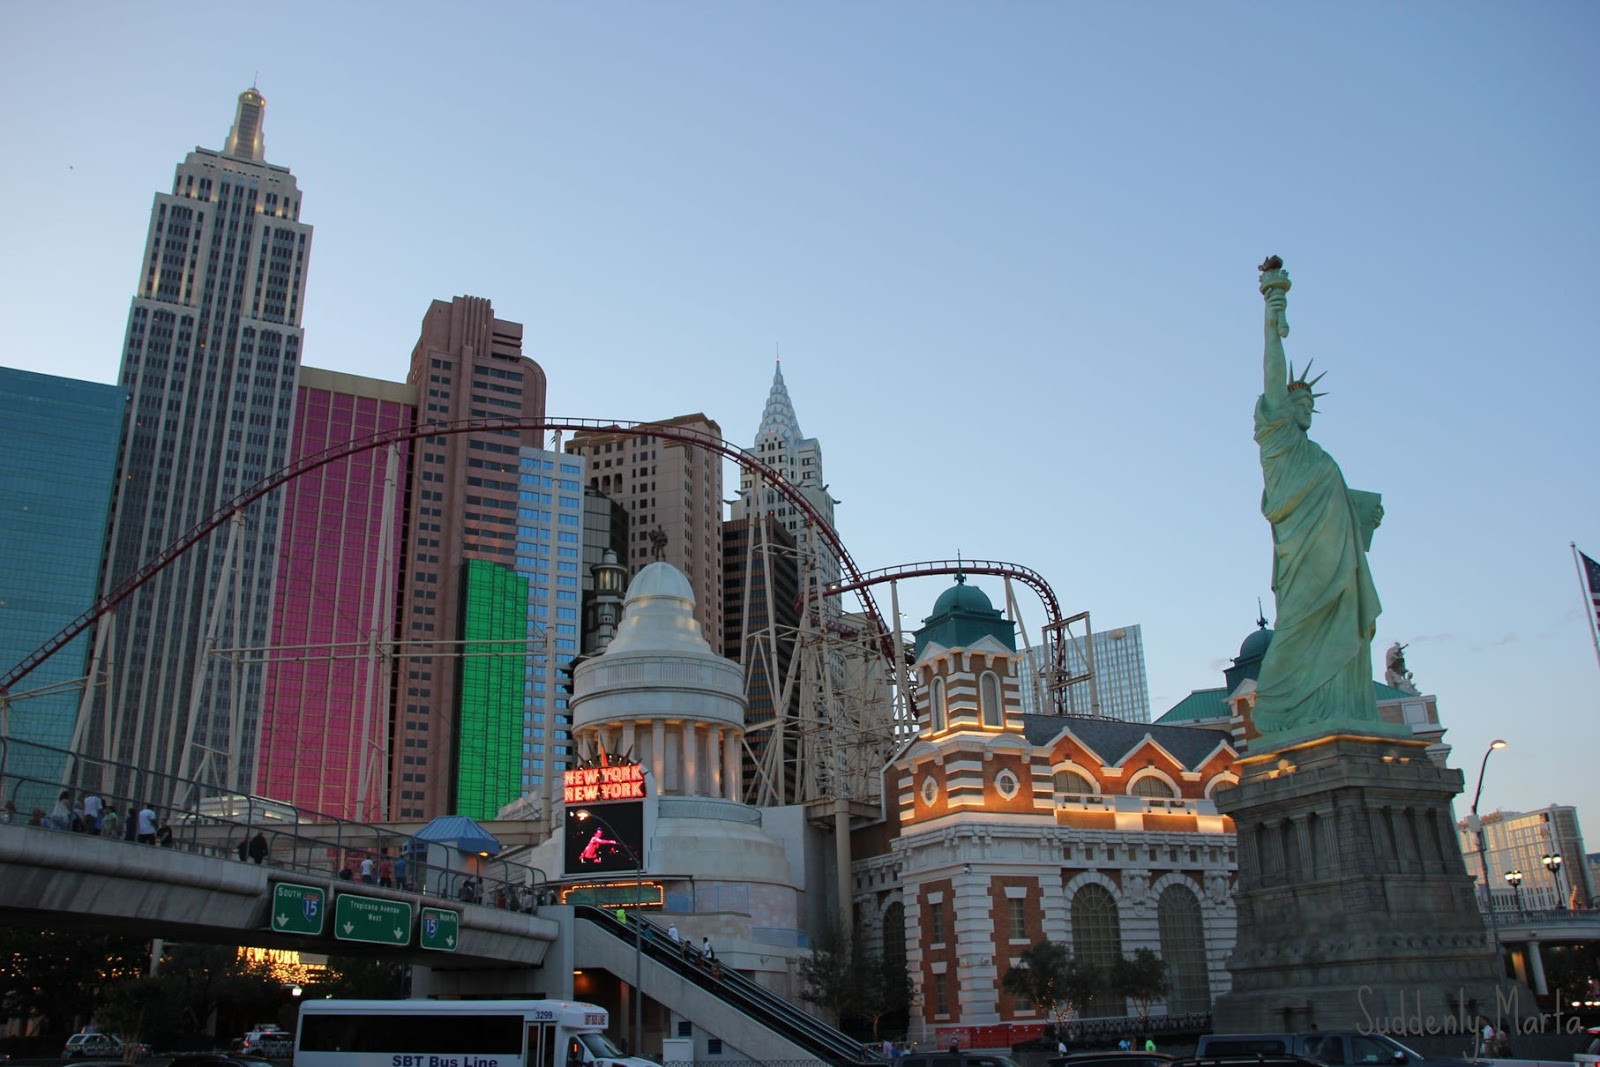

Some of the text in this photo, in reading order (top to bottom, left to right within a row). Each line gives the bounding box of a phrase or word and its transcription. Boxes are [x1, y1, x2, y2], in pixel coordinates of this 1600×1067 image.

[565, 765, 643, 787] NEW YORK
[565, 781, 644, 803] NEW YORK
[278, 887, 302, 899] SOUTH
[305, 900, 318, 916] 15
[350, 901, 400, 915] Tropicana Avenue
[368, 913, 382, 922] West
[426, 919, 436, 933] 15
[535, 1011, 553, 1020] 3299
[392, 1055, 498, 1067] SBT Bus Line
